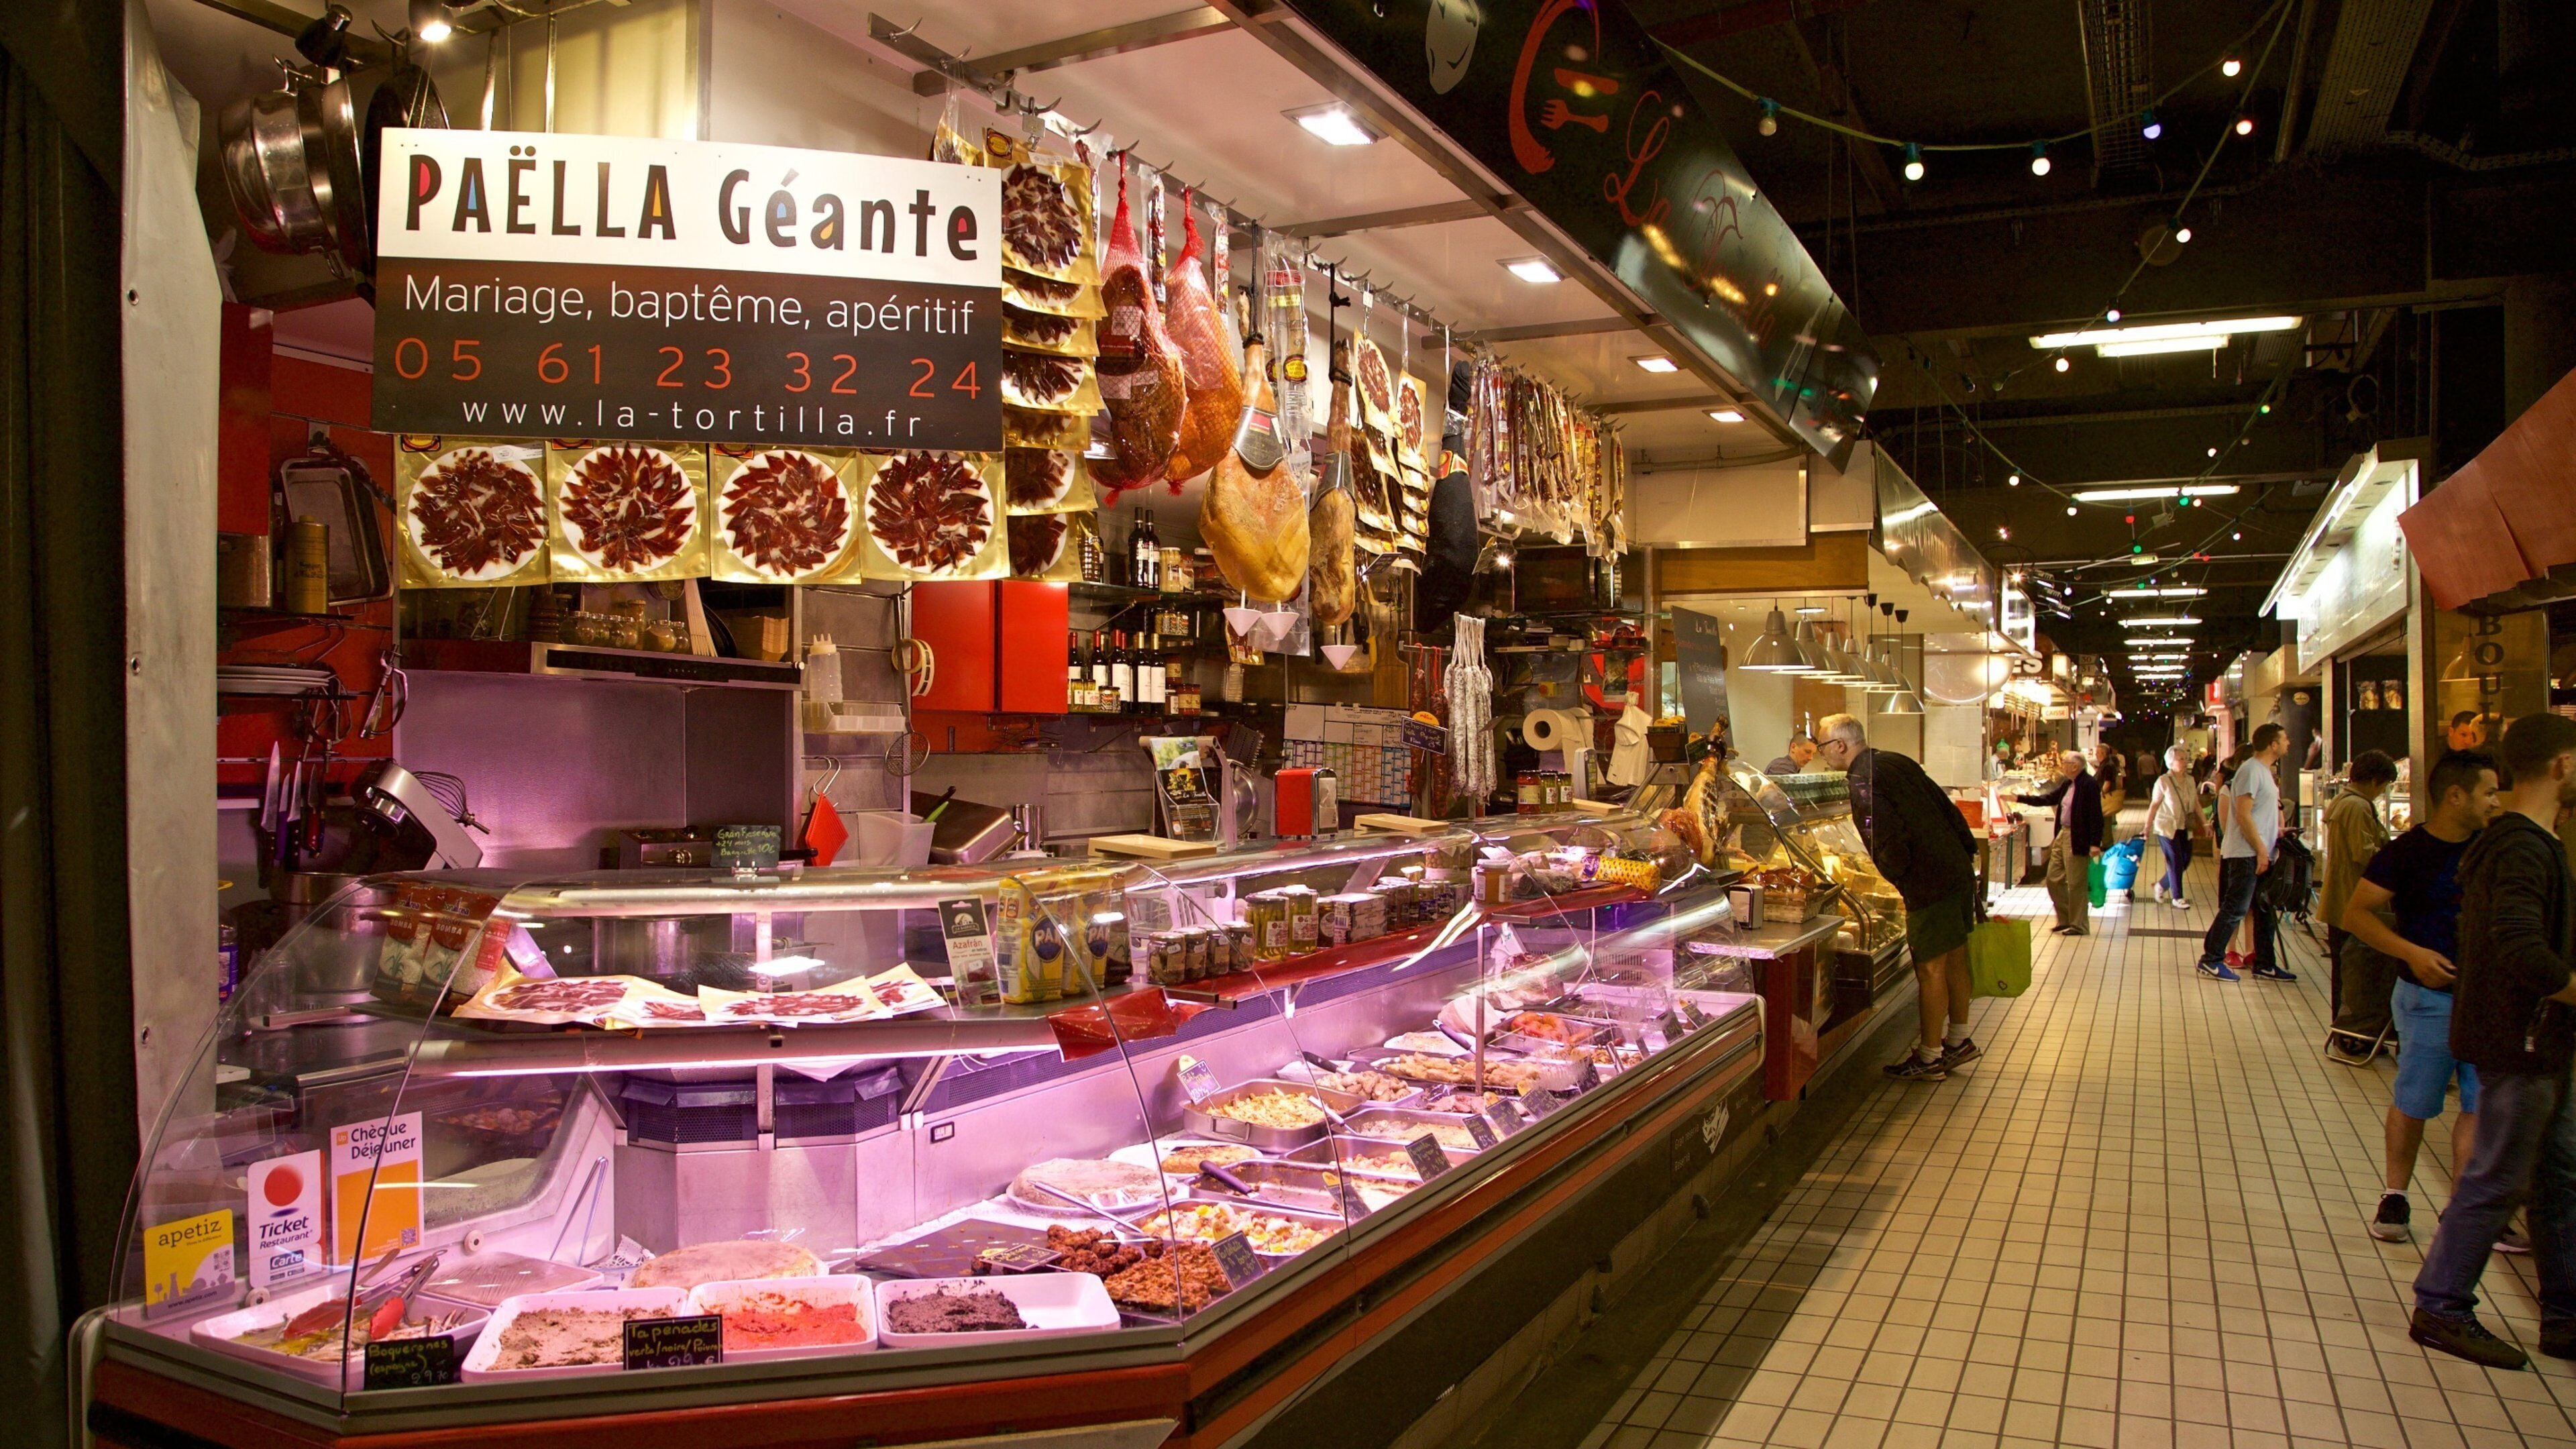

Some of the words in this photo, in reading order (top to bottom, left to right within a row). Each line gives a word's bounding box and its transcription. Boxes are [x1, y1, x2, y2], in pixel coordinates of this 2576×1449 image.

[405, 146, 677, 240] PAËLLA
[718, 169, 978, 261] Géante
[406, 274, 592, 323] Mariage,
[610, 282, 810, 329] baptême,
[826, 293, 974, 336] apéritif
[537, 341, 604, 384] 61
[657, 346, 732, 389] 23
[785, 352, 857, 394] 32
[910, 357, 981, 399] 24
[462, 398, 922, 437] www.la-tortilla.fr
[435, 923, 463, 936] BOMBA
[953, 939, 983, 950] Azafrán
[158, 1218, 222, 1248] apetiz
[259, 1216, 309, 1239] Ticket
[271, 1252, 303, 1268] Carte
[168, 1290, 218, 1309] www.apetiz.com
[369, 1339, 448, 1361] Boquerones
